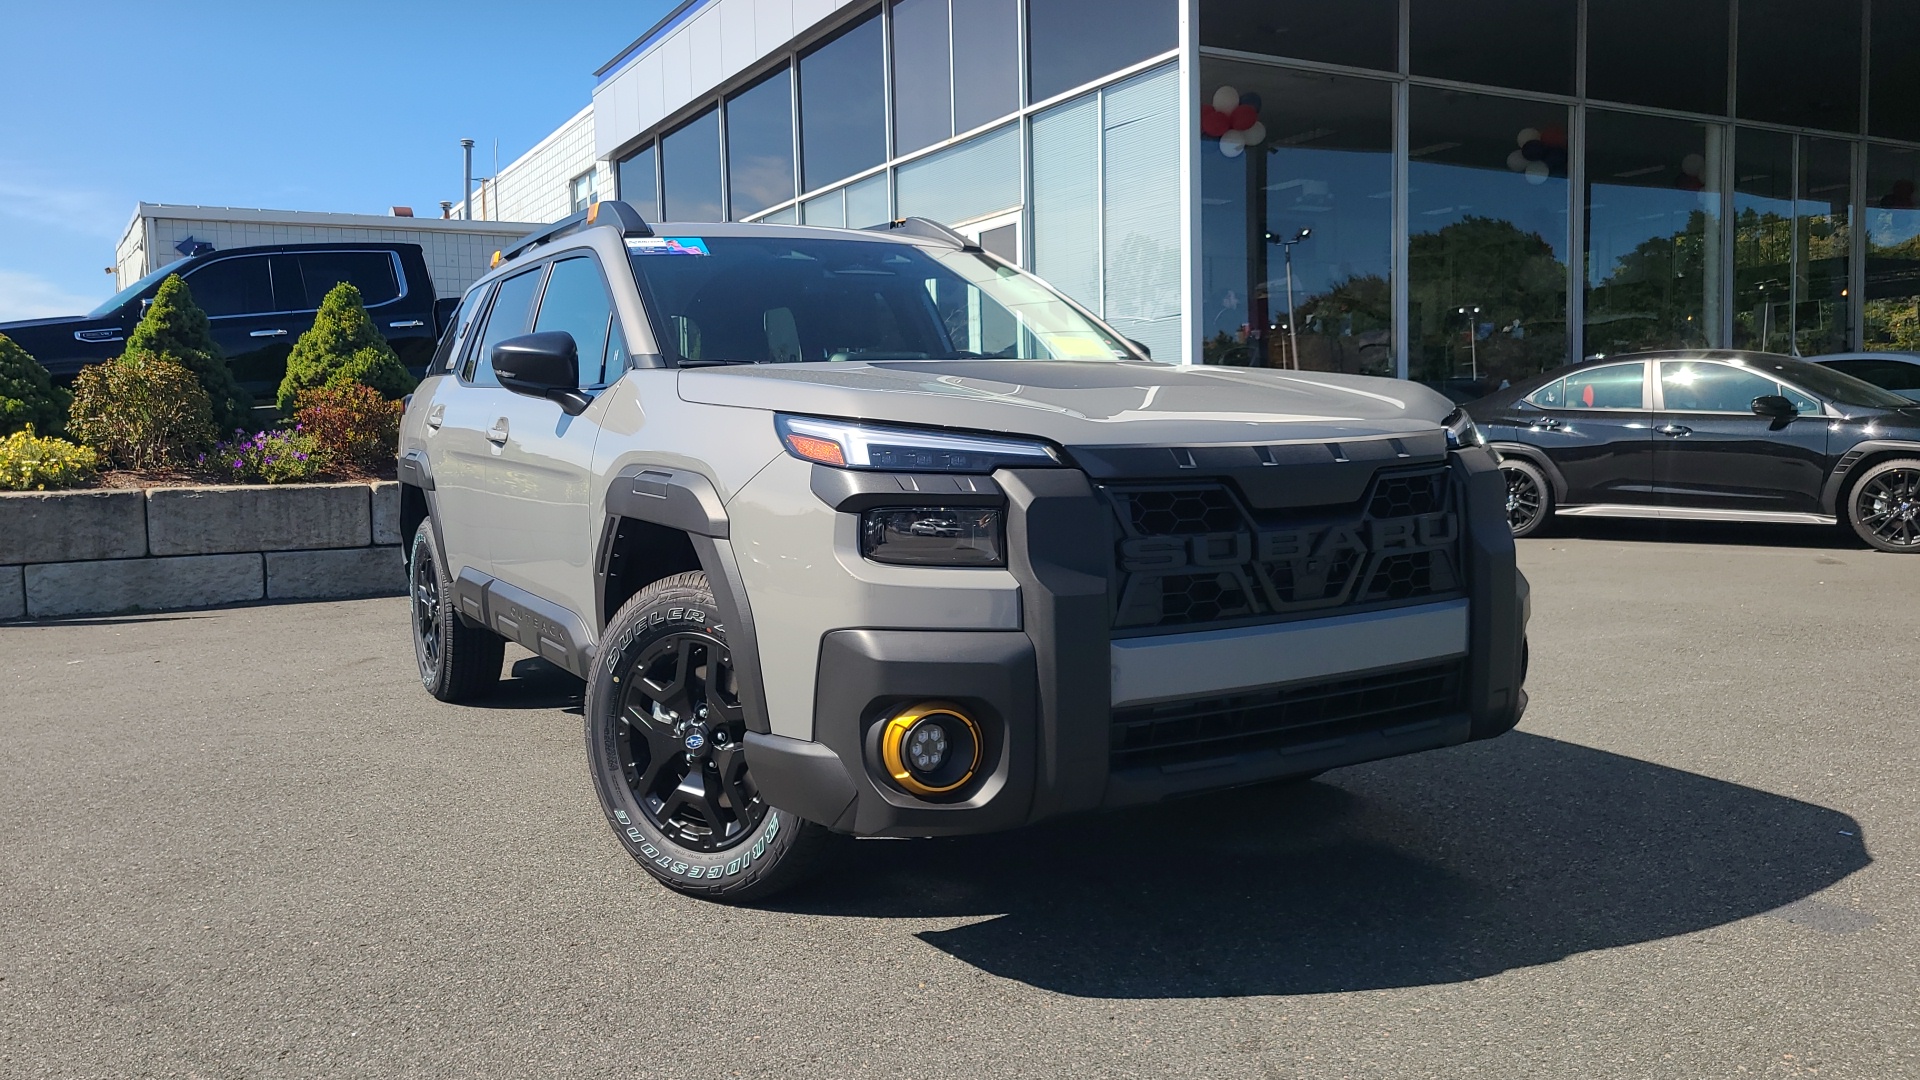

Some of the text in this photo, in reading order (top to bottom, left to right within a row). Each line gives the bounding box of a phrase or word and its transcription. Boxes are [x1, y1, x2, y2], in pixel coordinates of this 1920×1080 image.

[1117, 512, 1459, 573] SUBARU
[510, 607, 565, 641] OUTBACK
[606, 607, 706, 674] DUELER
[614, 812, 780, 879] BRIDGESTONE
